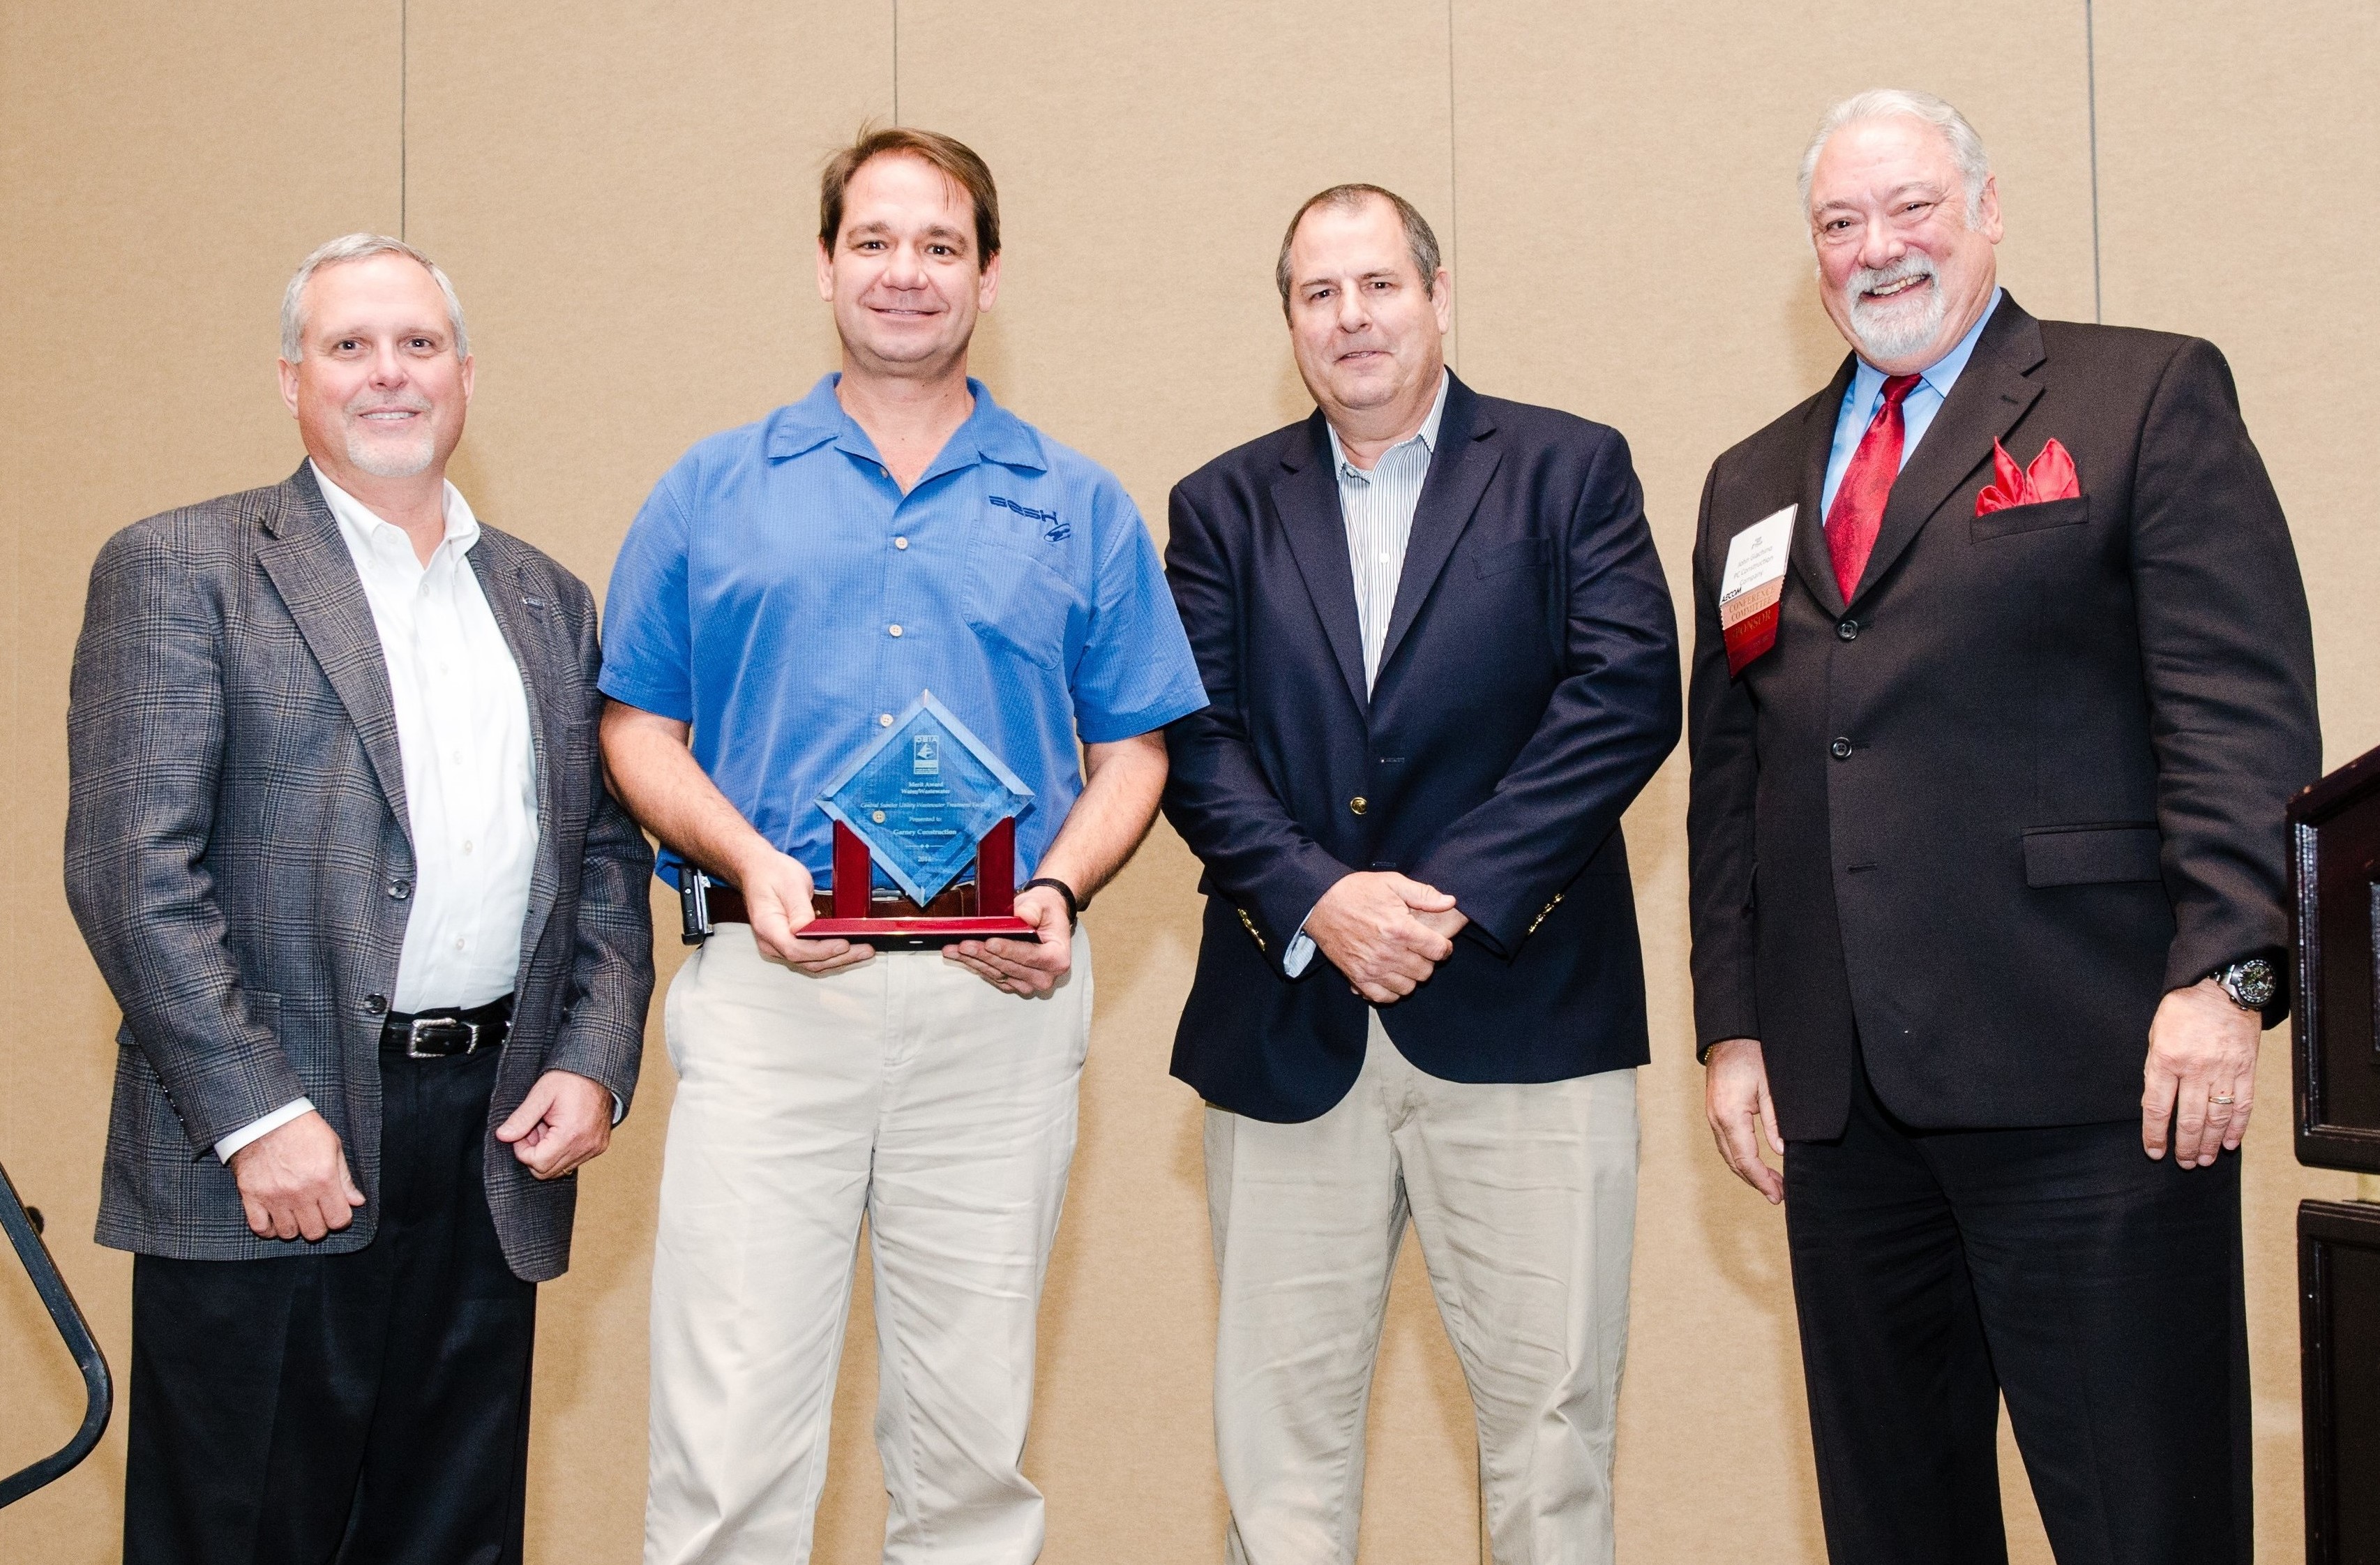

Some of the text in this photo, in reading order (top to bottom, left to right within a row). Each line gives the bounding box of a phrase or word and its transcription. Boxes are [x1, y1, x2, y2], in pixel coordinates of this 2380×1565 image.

[1722, 587, 1742, 602] AECOM
[1729, 585, 1775, 613] CONFERENCE
[1731, 596, 1772, 622] COMMITTEE
